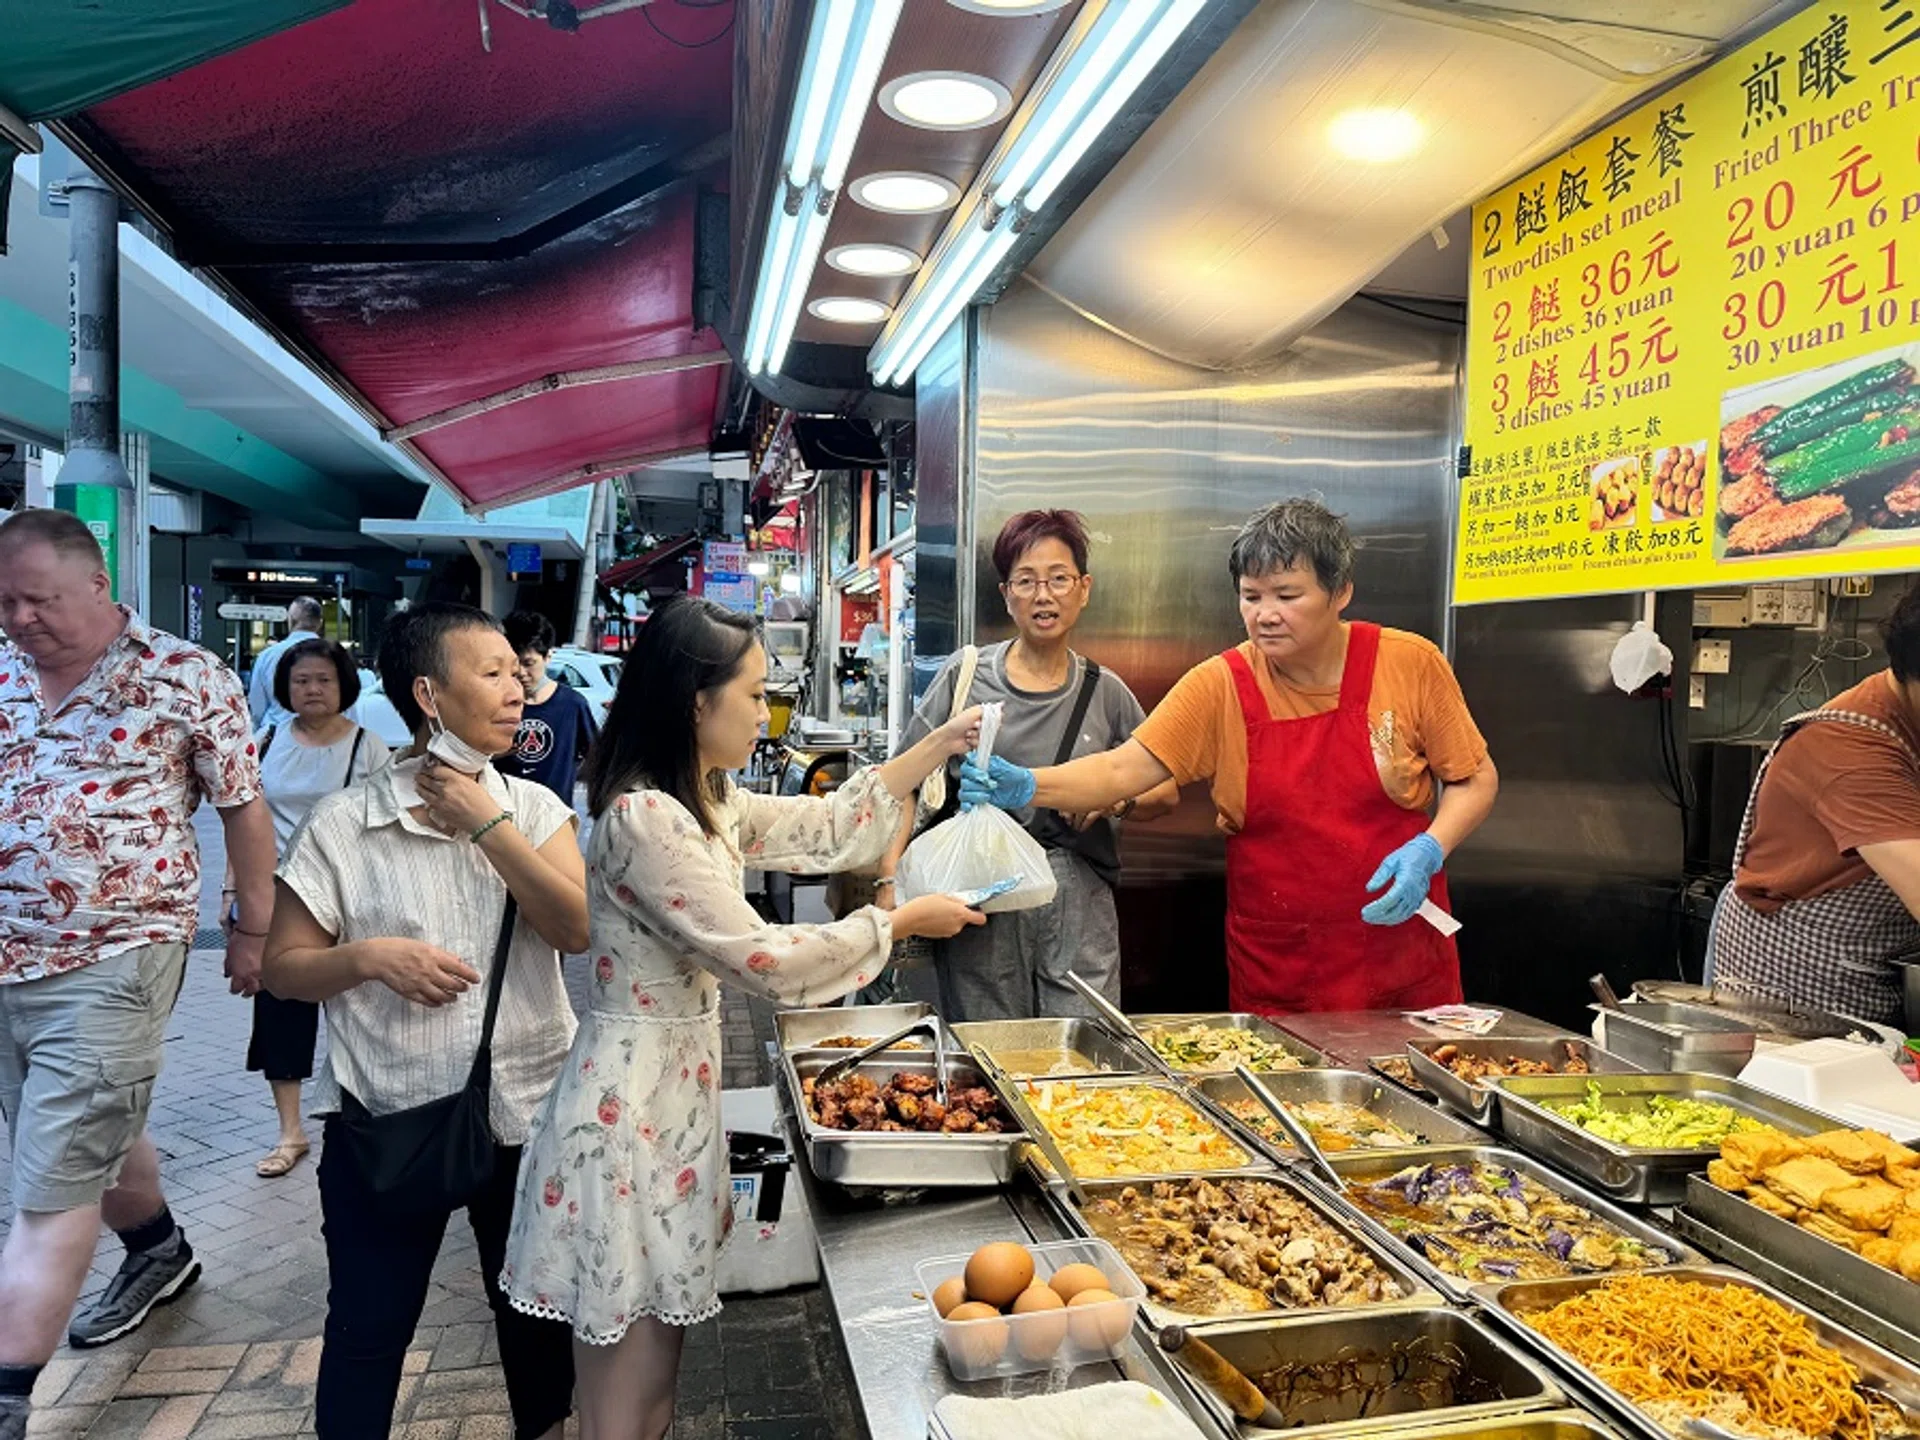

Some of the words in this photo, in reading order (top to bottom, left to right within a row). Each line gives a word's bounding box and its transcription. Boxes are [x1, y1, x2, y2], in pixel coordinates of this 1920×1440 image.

[1713, 135, 1780, 190] Fried
[1788, 100, 1872, 154] Three
[1483, 232, 1574, 290] Two-dish
[1581, 212, 1613, 247] set
[1621, 177, 1682, 229] meal
[1730, 246, 1765, 280] 20
[1775, 218, 1856, 267] yuan
[1868, 196, 1888, 227] 6
[1496, 344, 1507, 363] 2
[1512, 323, 1574, 358] dishes
[1581, 305, 1607, 334] 36
[1614, 286, 1674, 325] yuan
[1727, 339, 1760, 370] 30
[1769, 321, 1844, 363] yuan
[1859, 299, 1898, 334] 10
[1494, 414, 1505, 434] 3
[1511, 399, 1573, 430] dishes
[1580, 385, 1605, 411] 45
[1613, 371, 1671, 406] yuan
